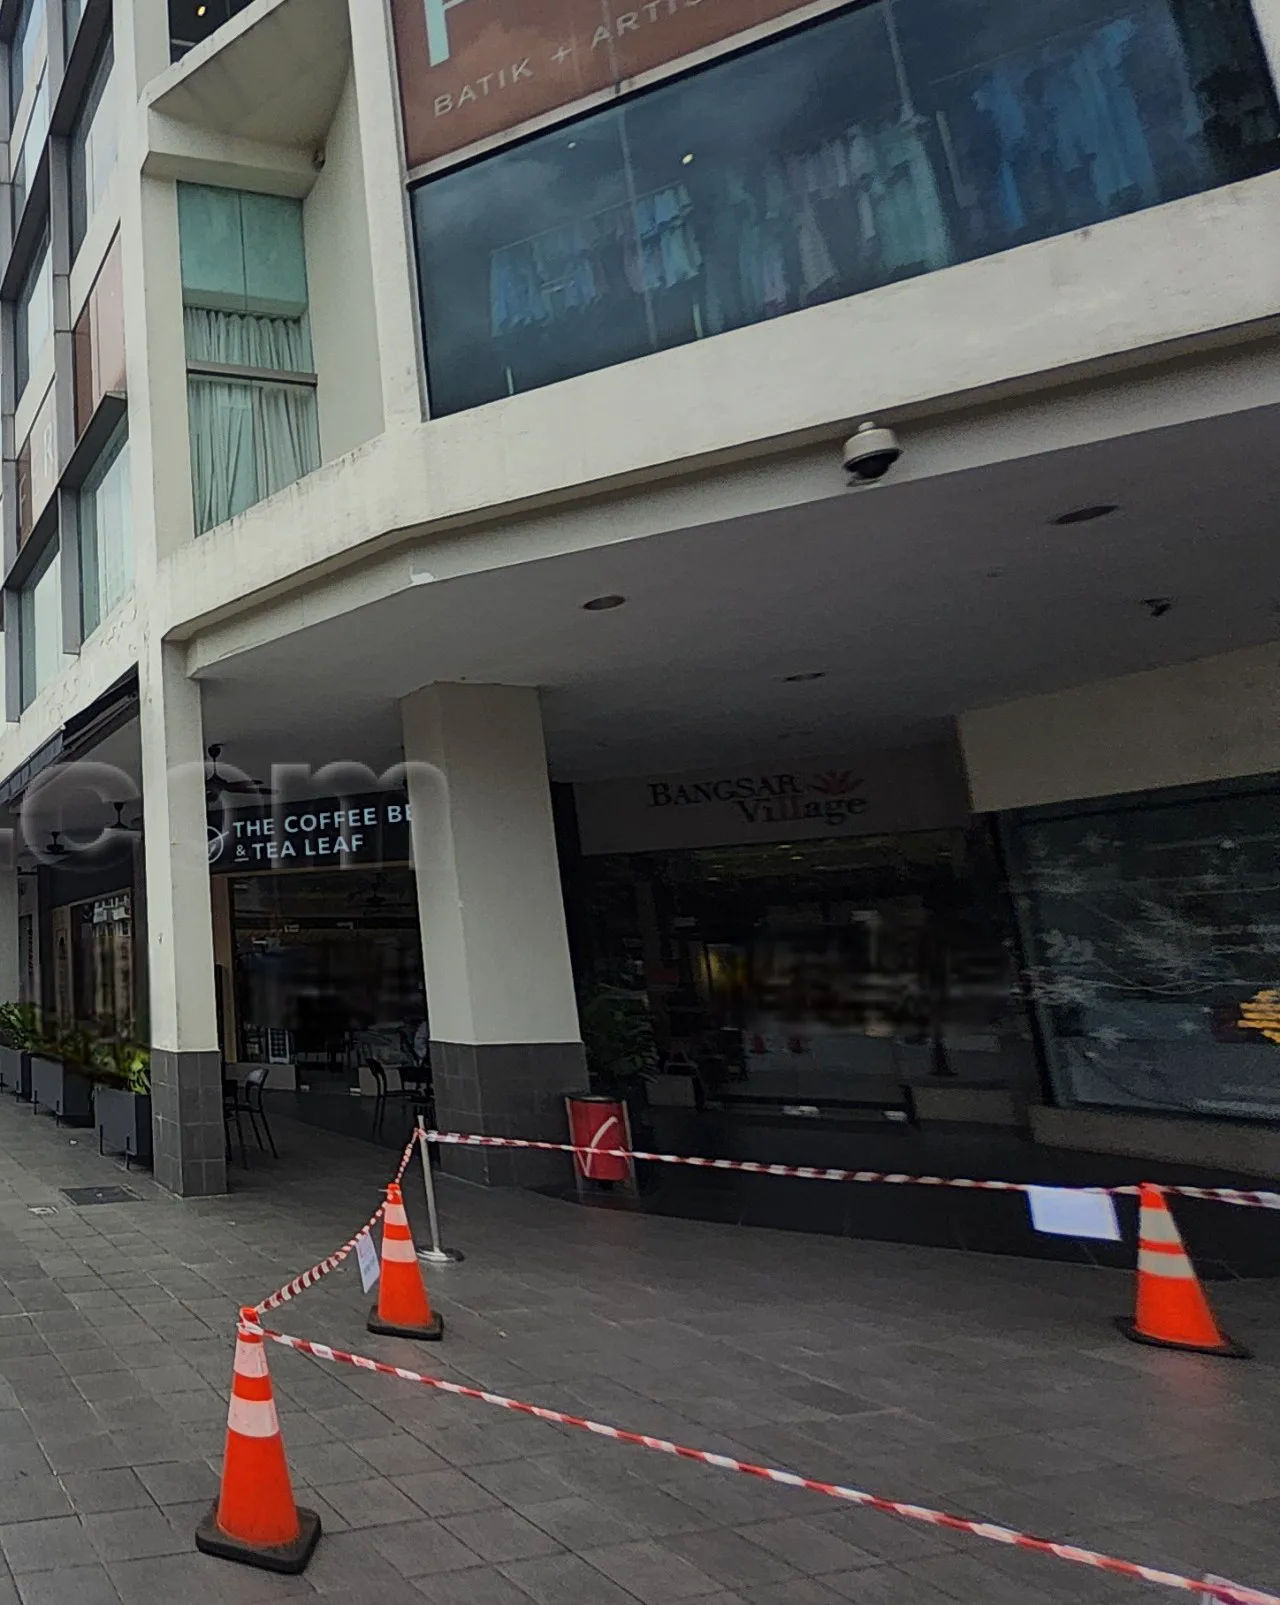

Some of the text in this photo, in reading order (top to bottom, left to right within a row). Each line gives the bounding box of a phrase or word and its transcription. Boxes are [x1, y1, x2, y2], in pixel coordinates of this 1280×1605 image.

[432, 56, 535, 117] BATIK
[646, 774, 803, 808] BANGSAR
[232, 818, 276, 838] THE
[283, 807, 378, 833] COFFEE
[734, 796, 868, 826] Village
[234, 834, 364, 862] & TEA LEAF
